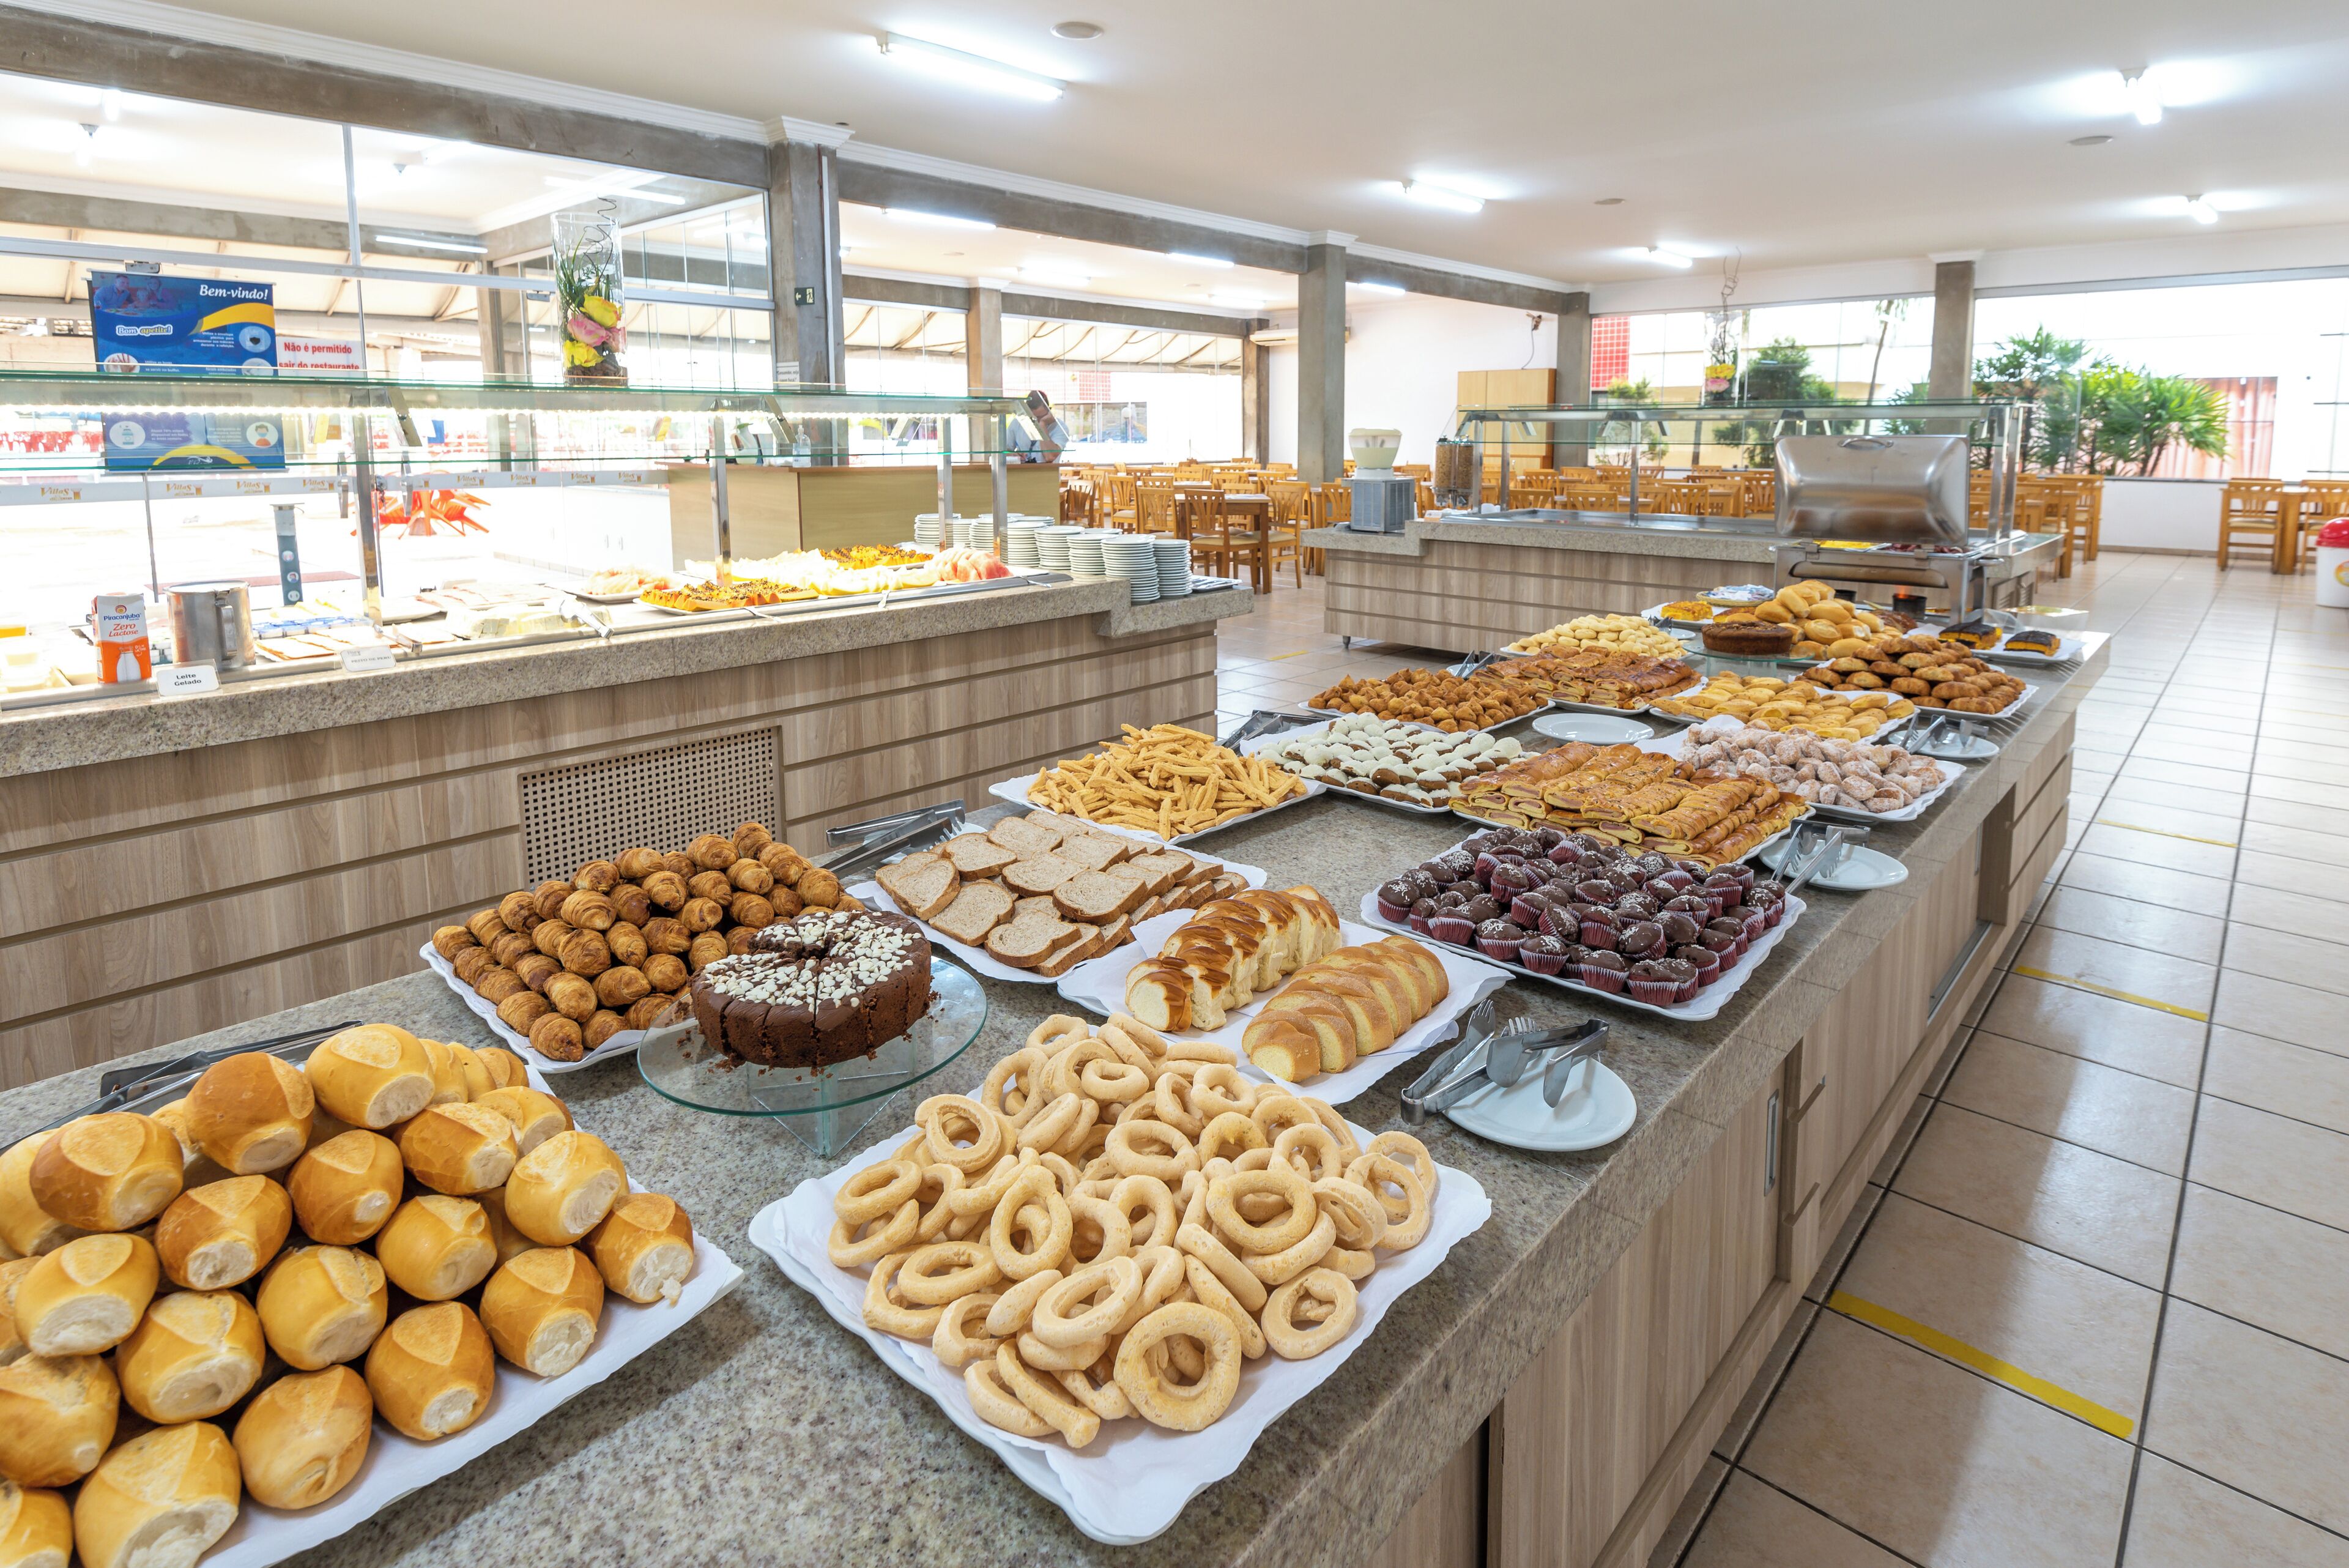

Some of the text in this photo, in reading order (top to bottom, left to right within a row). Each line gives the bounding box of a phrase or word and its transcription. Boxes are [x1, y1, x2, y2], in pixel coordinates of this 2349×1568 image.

[199, 284, 269, 300] Bem-vindo!
[117, 325, 171, 336] Bom apetite!
[284, 342, 352, 354] Não é permitido
